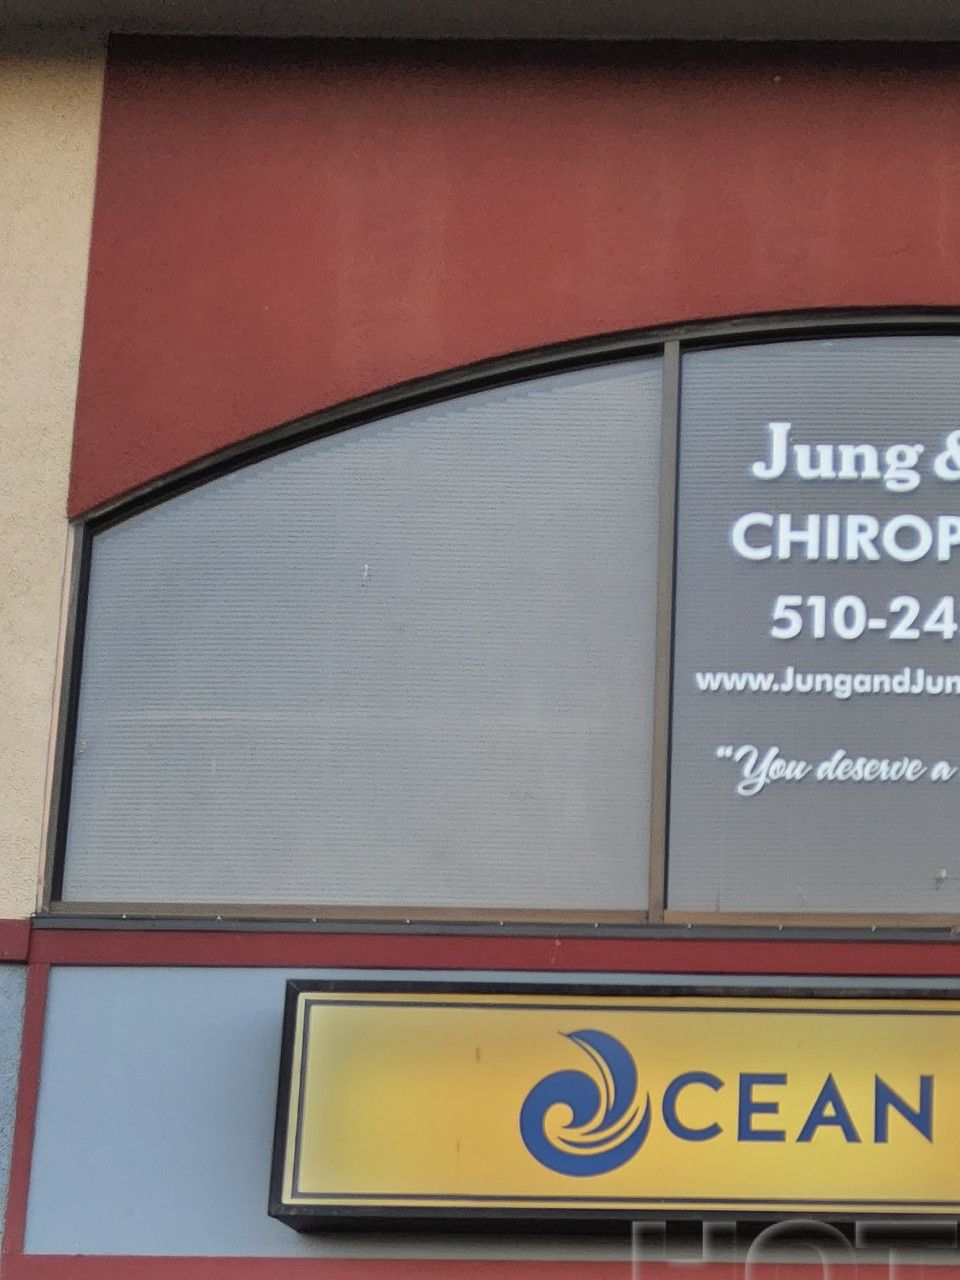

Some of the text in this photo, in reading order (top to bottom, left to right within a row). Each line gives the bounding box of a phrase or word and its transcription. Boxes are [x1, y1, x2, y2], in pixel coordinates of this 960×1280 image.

[751, 422, 924, 492] Jung
[816, 749, 927, 783] deserve
[931, 760, 958, 782] a
